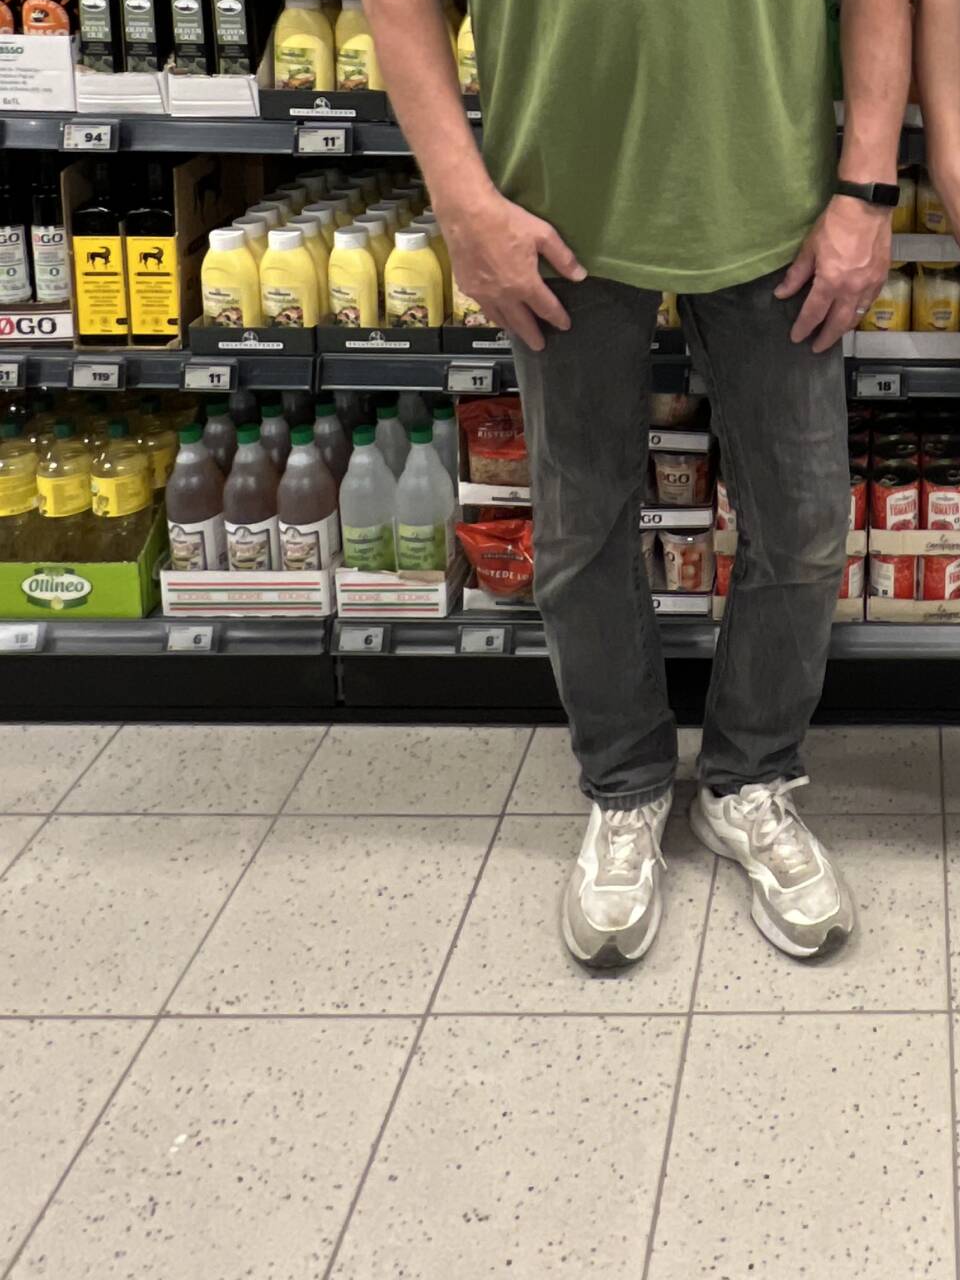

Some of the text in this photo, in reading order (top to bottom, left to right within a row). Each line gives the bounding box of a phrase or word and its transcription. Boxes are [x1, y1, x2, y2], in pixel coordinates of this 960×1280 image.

[125, 26, 153, 34] OLIVEN
[174, 27, 202, 35] OLIVEN
[217, 28, 245, 36] OLIVEN
[84, 132, 103, 143] 94
[322, 136, 336, 147] 11
[0, 232, 20, 244] GO
[33, 232, 64, 244] ØGO
[91, 372, 110, 382] 119
[208, 373, 222, 384] 11
[471, 375, 484, 387] 11
[876, 381, 892, 392] 18
[930, 502, 960, 516] TOMATER
[641, 513, 663, 524] GO
[28, 578, 85, 593] Ollineo
[192, 633, 202, 645] 6
[363, 635, 374, 646] 6
[485, 635, 494, 646] 8
